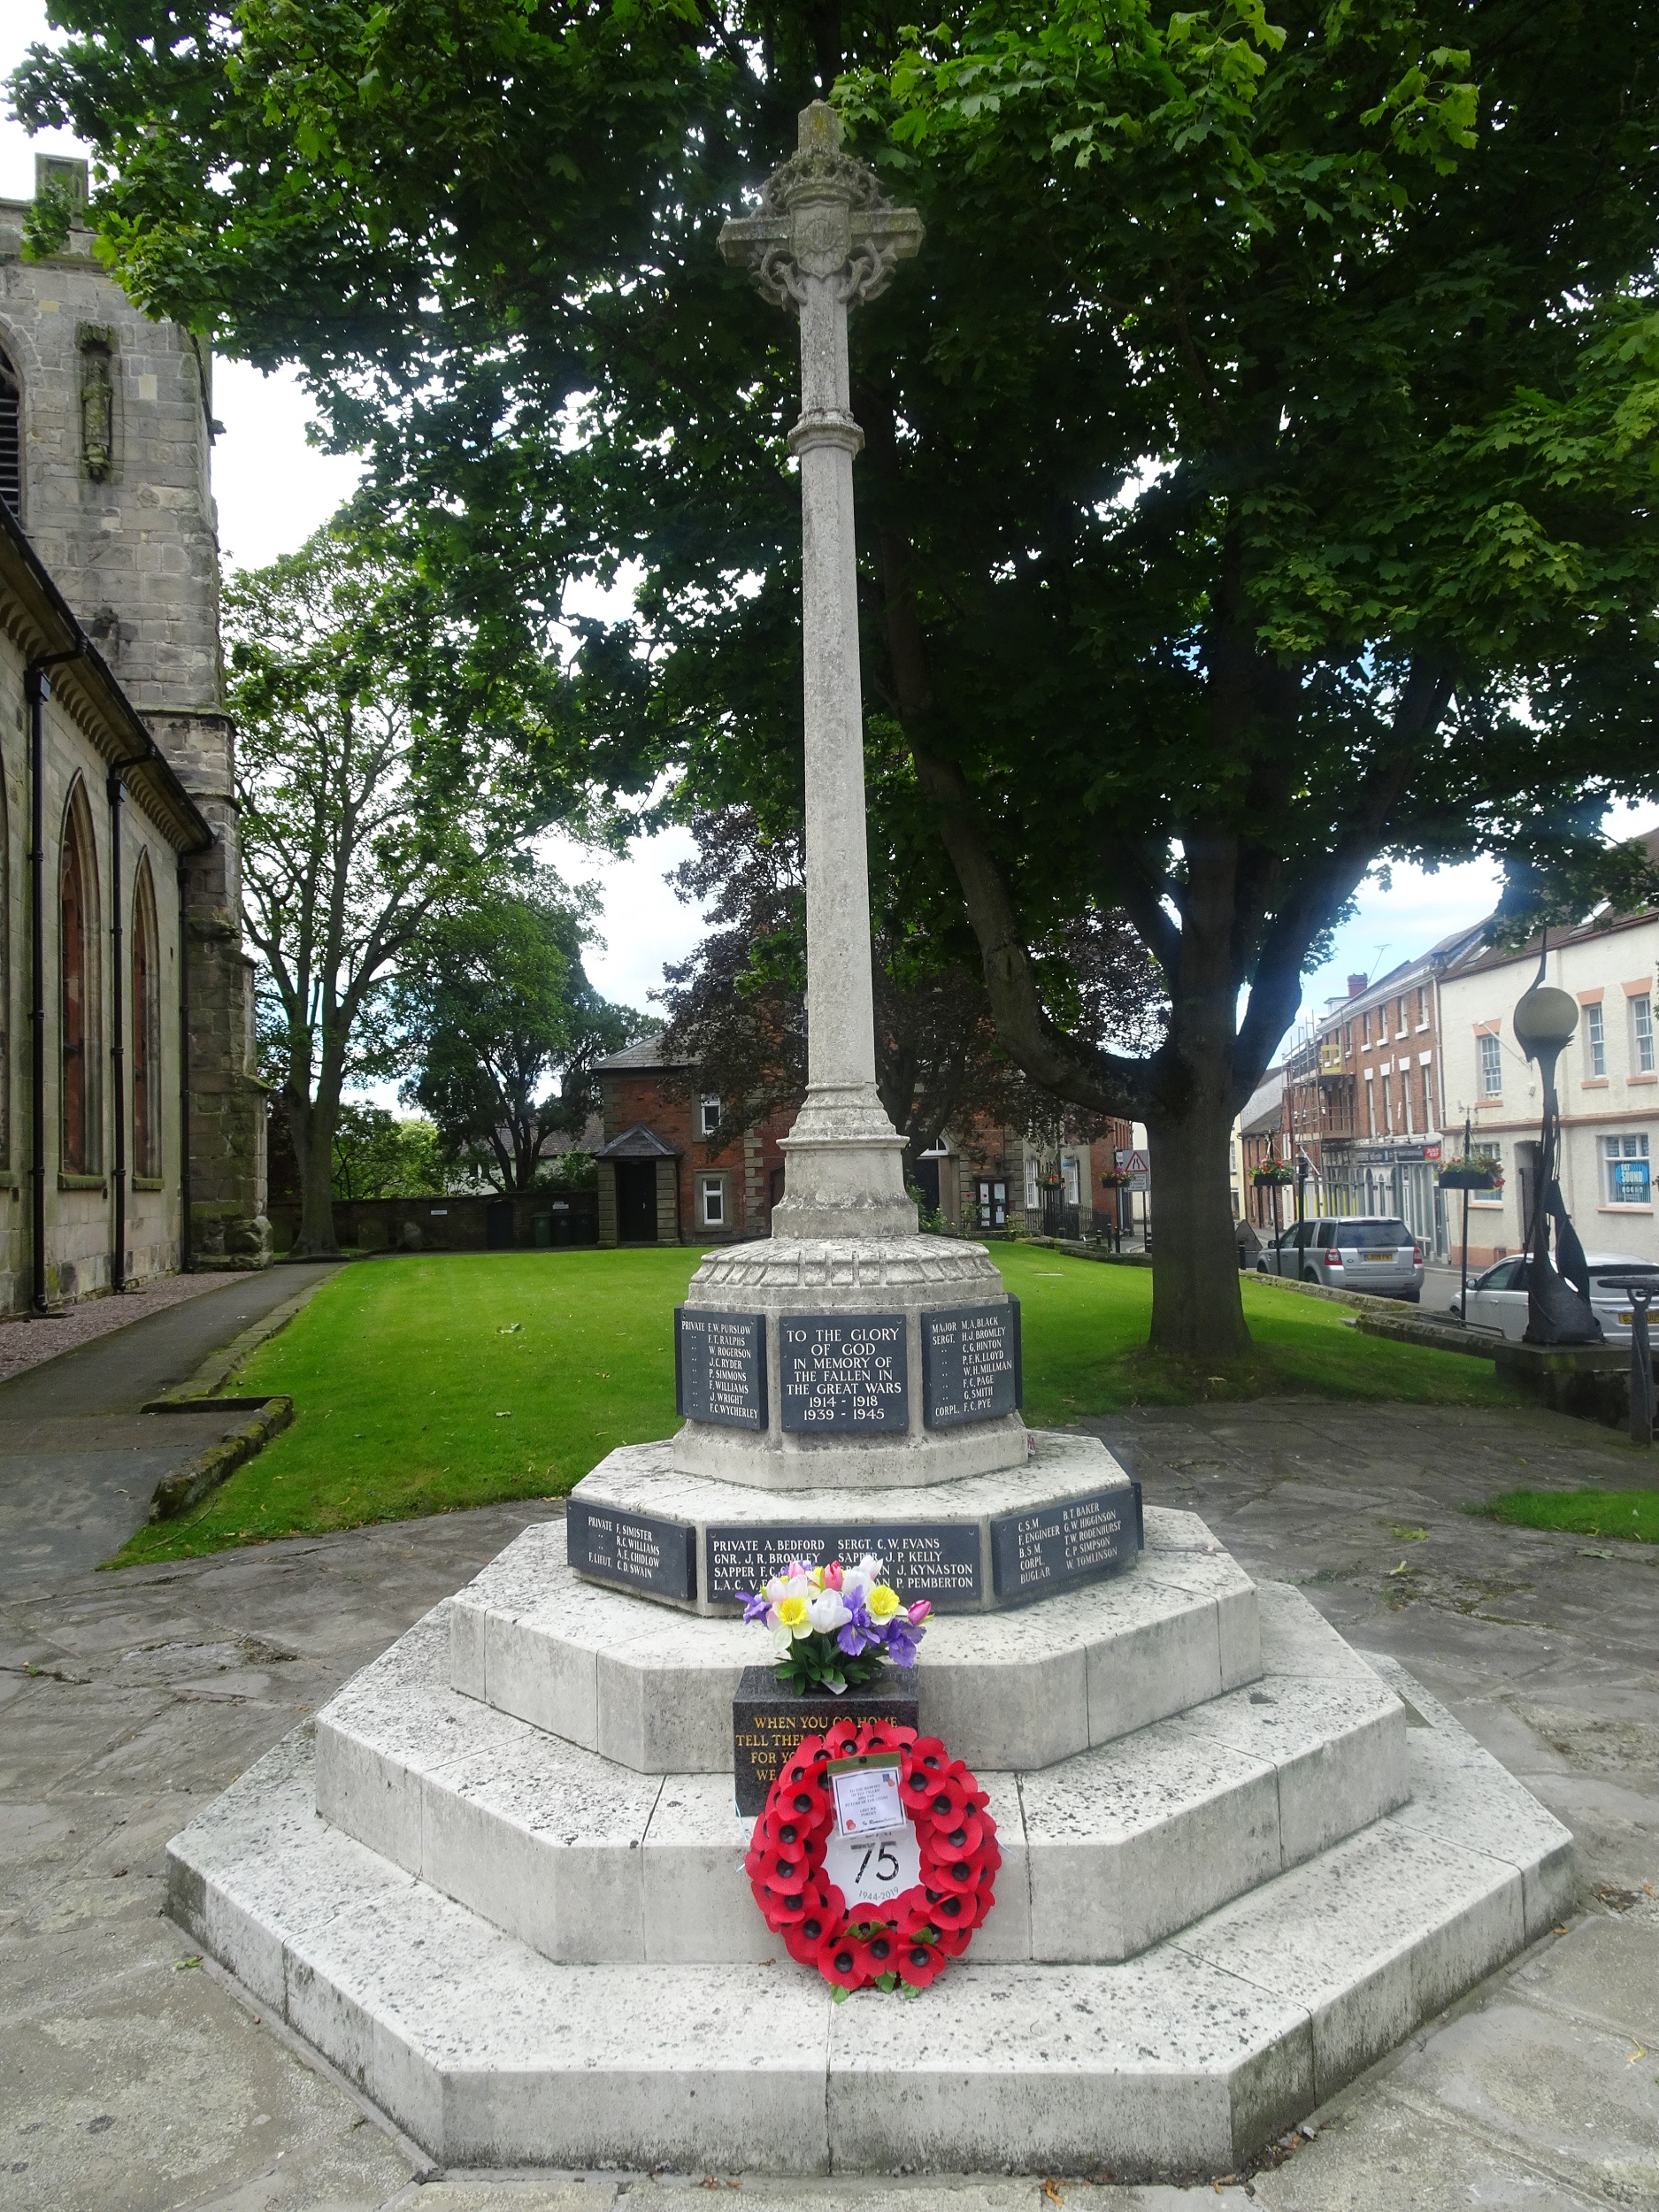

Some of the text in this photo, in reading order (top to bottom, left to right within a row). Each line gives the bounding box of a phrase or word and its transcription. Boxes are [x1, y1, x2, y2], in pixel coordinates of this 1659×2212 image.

[1621, 1171, 1643, 1183] SOUND
[682, 1321, 704, 1331] PRIVATE
[721, 1325, 751, 1334] PURSLOW
[933, 1322, 956, 1333] MAJOR
[977, 1317, 998, 1327] BLACK
[720, 1336, 745, 1346] RALPHS
[787, 1328, 899, 1342] TO THE GLORY
[933, 1334, 955, 1345] SERGT.
[976, 1327, 1006, 1340] BROMLEY
[811, 1343, 875, 1356] OF GOD
[976, 1340, 1002, 1351] HINTON
[718, 1347, 751, 1358] ROGERSON
[983, 1350, 1003, 1362] LLOYD
[721, 1359, 742, 1370] RYDER
[794, 1357, 892, 1369] IN MEMORY OF
[980, 1360, 1012, 1374] MILLMAN
[716, 1370, 747, 1381] SIMMONS
[795, 1370, 892, 1382] THE FALLEN IN
[977, 1375, 994, 1386] PAGE
[716, 1381, 749, 1394] WILLIAMS
[787, 1382, 902, 1394] THE GREAT WARS
[972, 1386, 993, 1398] SMITH
[718, 1393, 743, 1404] WRIGHT
[810, 1396, 836, 1408] 1914
[853, 1395, 878, 1407] 1918
[720, 1405, 757, 1418] WYCHERLEY
[804, 1409, 834, 1420] 1939
[854, 1409, 885, 1419] 1945
[936, 1405, 959, 1417] CORPL.
[978, 1399, 991, 1409] PYE
[1077, 1502, 1100, 1517] BAKER
[588, 1517, 612, 1532] PRIVATE
[623, 1525, 652, 1541] SIMISTER
[1025, 1525, 1060, 1543] ENGINEER
[1079, 1509, 1116, 1529] HIGGINSON
[1079, 1520, 1121, 1541] RODENHURST
[628, 1539, 659, 1555] WILLIAMS
[713, 1540, 758, 1551] PRIVATE
[778, 1540, 825, 1551] BEDFORD
[838, 1540, 872, 1549] SERGT.
[902, 1539, 940, 1548] EVANS
[631, 1552, 659, 1568] CHIDLOW
[714, 1554, 741, 1564] GNR.
[838, 1552, 879, 1563] SAPPR
[909, 1552, 942, 1562] KELLY
[1020, 1555, 1045, 1571] CORPL.
[1079, 1536, 1110, 1553] SIMPSON
[630, 1564, 652, 1578] SWAIN
[714, 1567, 755, 1578] SAPPER
[910, 1564, 972, 1575] KYNASTON
[1021, 1567, 1050, 1585] BUGLAR
[1077, 1547, 1118, 1567] TOMLINSON
[908, 1578, 972, 1588] PEMBERTON
[754, 1717, 795, 1729] WHEN
[800, 1717, 828, 1728] YOU
[857, 1717, 898, 1728] HOE
[736, 1735, 769, 1747] TELL
[772, 1734, 805, 1747] THE
[751, 1752, 777, 1763] FOR
[757, 1770, 776, 1781] WE
[851, 1841, 899, 1884] 75
[859, 1886, 899, 1901] 1944-2019
